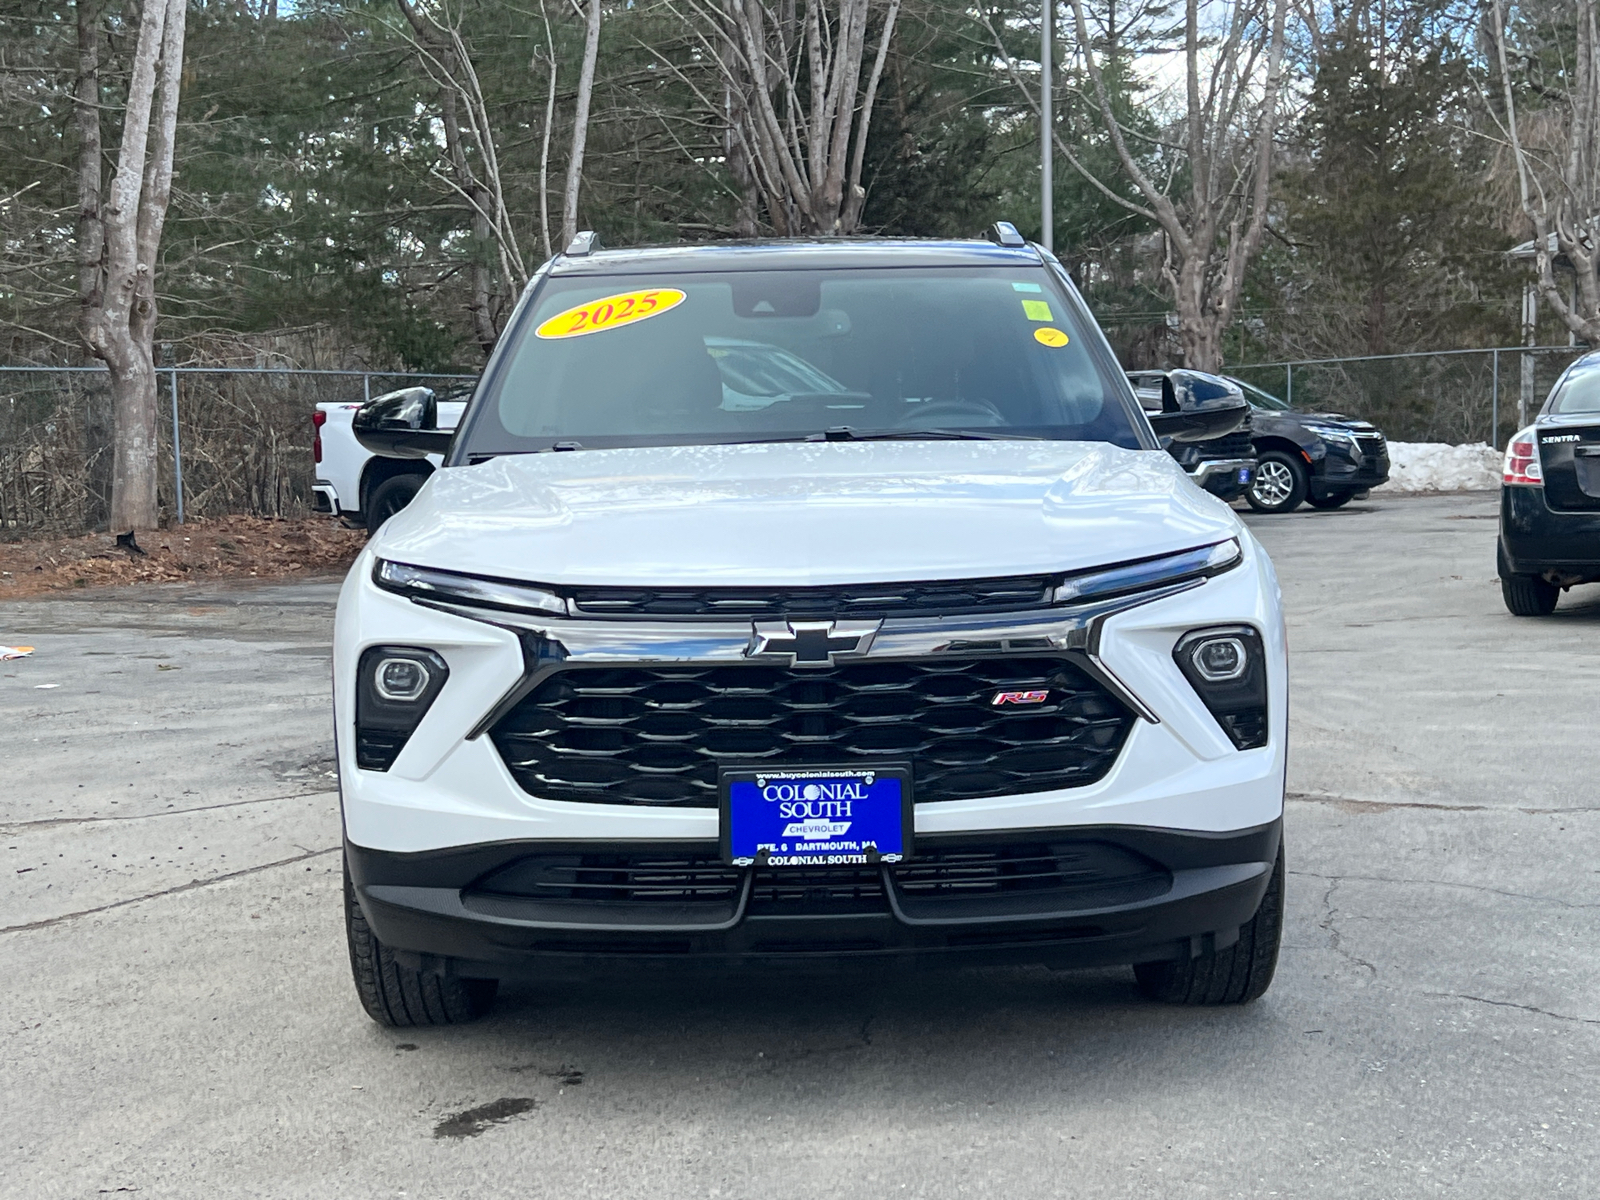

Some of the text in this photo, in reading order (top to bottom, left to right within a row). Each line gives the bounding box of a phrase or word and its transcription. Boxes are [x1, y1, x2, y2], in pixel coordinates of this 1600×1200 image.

[567, 292, 660, 333] 2025
[1541, 434, 1581, 444] SENTRA
[991, 690, 1050, 705] RS
[756, 770, 875, 780] www.buycolonialsouth.com
[763, 783, 868, 801] COLONIAL
[780, 801, 852, 818] SOUTH
[789, 824, 845, 834] CHEVROLET
[781, 843, 788, 852] 6
[795, 841, 860, 852] DARTMOUTH,
[767, 854, 867, 865] COLONIAL SOUTH
